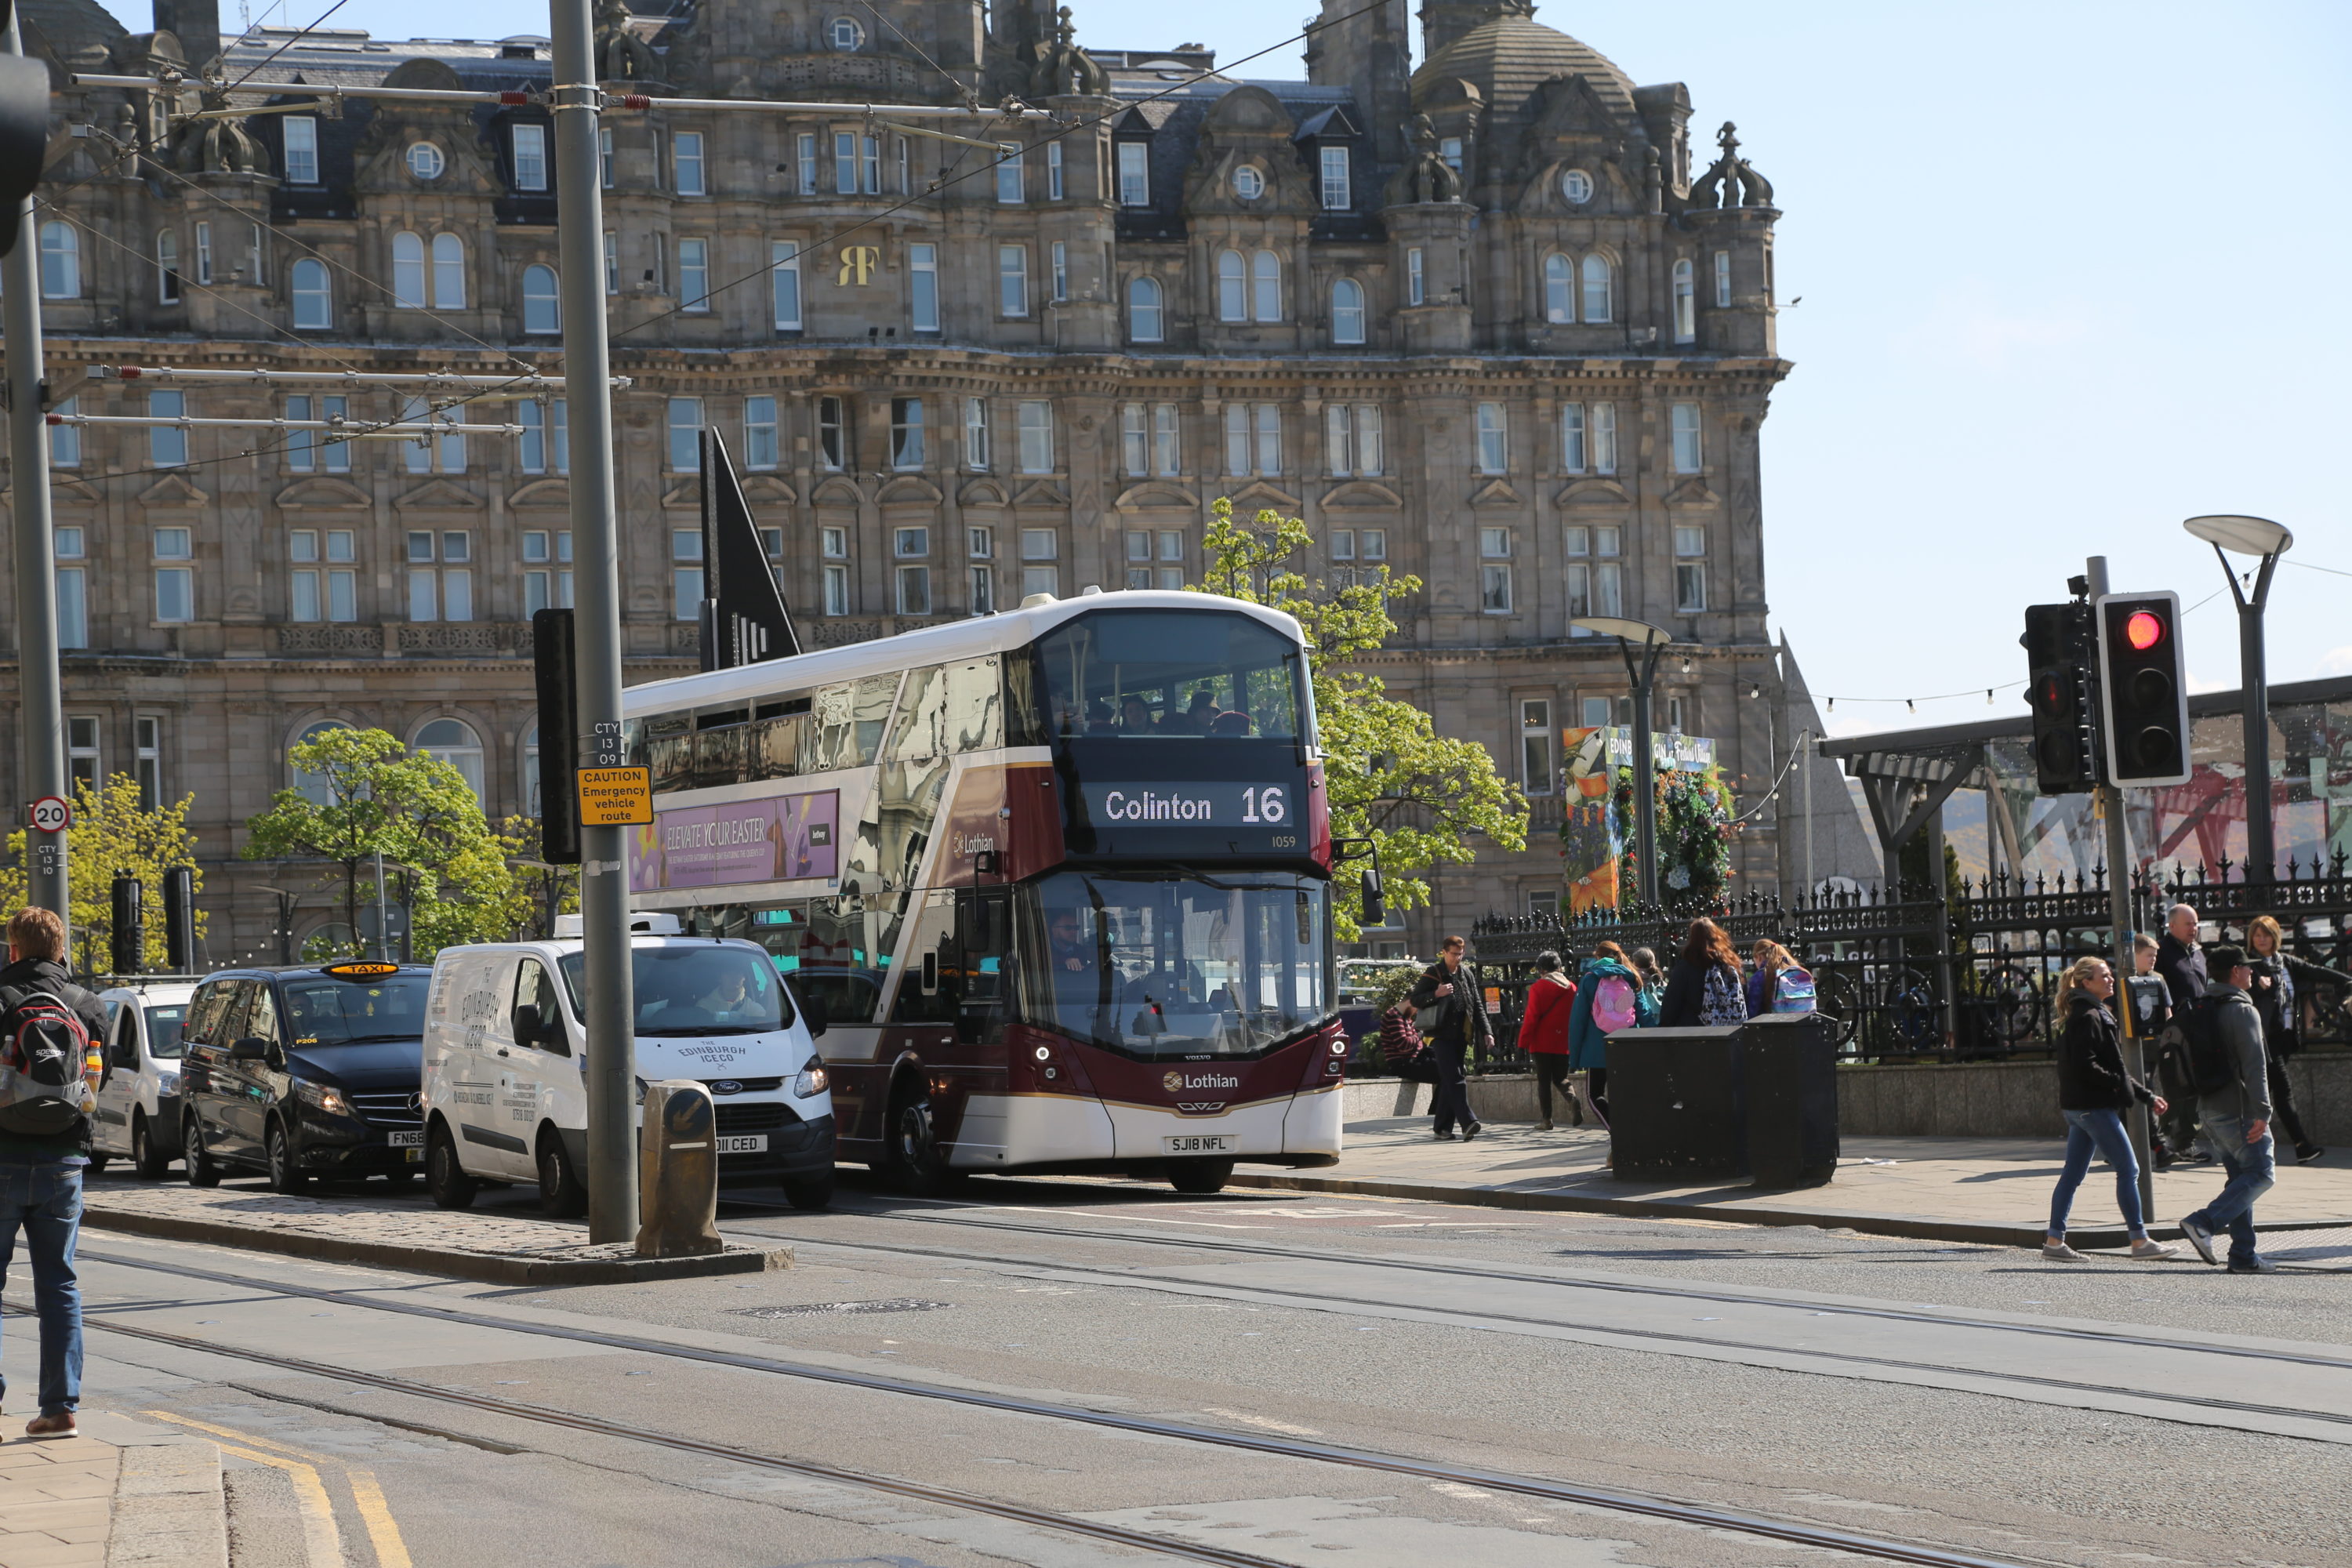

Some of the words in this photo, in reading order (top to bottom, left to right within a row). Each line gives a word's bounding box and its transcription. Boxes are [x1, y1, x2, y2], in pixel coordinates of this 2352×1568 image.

[595, 723, 619, 734] CTY
[602, 739, 613, 749] 13
[1610, 738, 1632, 754] EDINB
[599, 754, 616, 764] 09
[584, 771, 641, 782] CAUTION
[583, 786, 646, 797] Emergency
[594, 798, 635, 809] vehicle
[1105, 791, 1211, 820] Colinton
[1242, 786, 1285, 822] 16
[37, 808, 64, 822] 20
[601, 811, 632, 821] route
[667, 824, 701, 851] ELEVATE
[703, 822, 730, 848] YOUR
[732, 817, 765, 844] EASTER
[964, 833, 993, 853] Lothian
[1272, 837, 1296, 848] 1059
[462, 991, 500, 1024] EDINBURGH
[678, 1047, 746, 1057] EDINBURGH
[1185, 1074, 1238, 1088] Lothian
[732, 1138, 757, 1151] CED
[1172, 1138, 1200, 1151] SJ18
[1203, 1138, 1226, 1150] NFL
